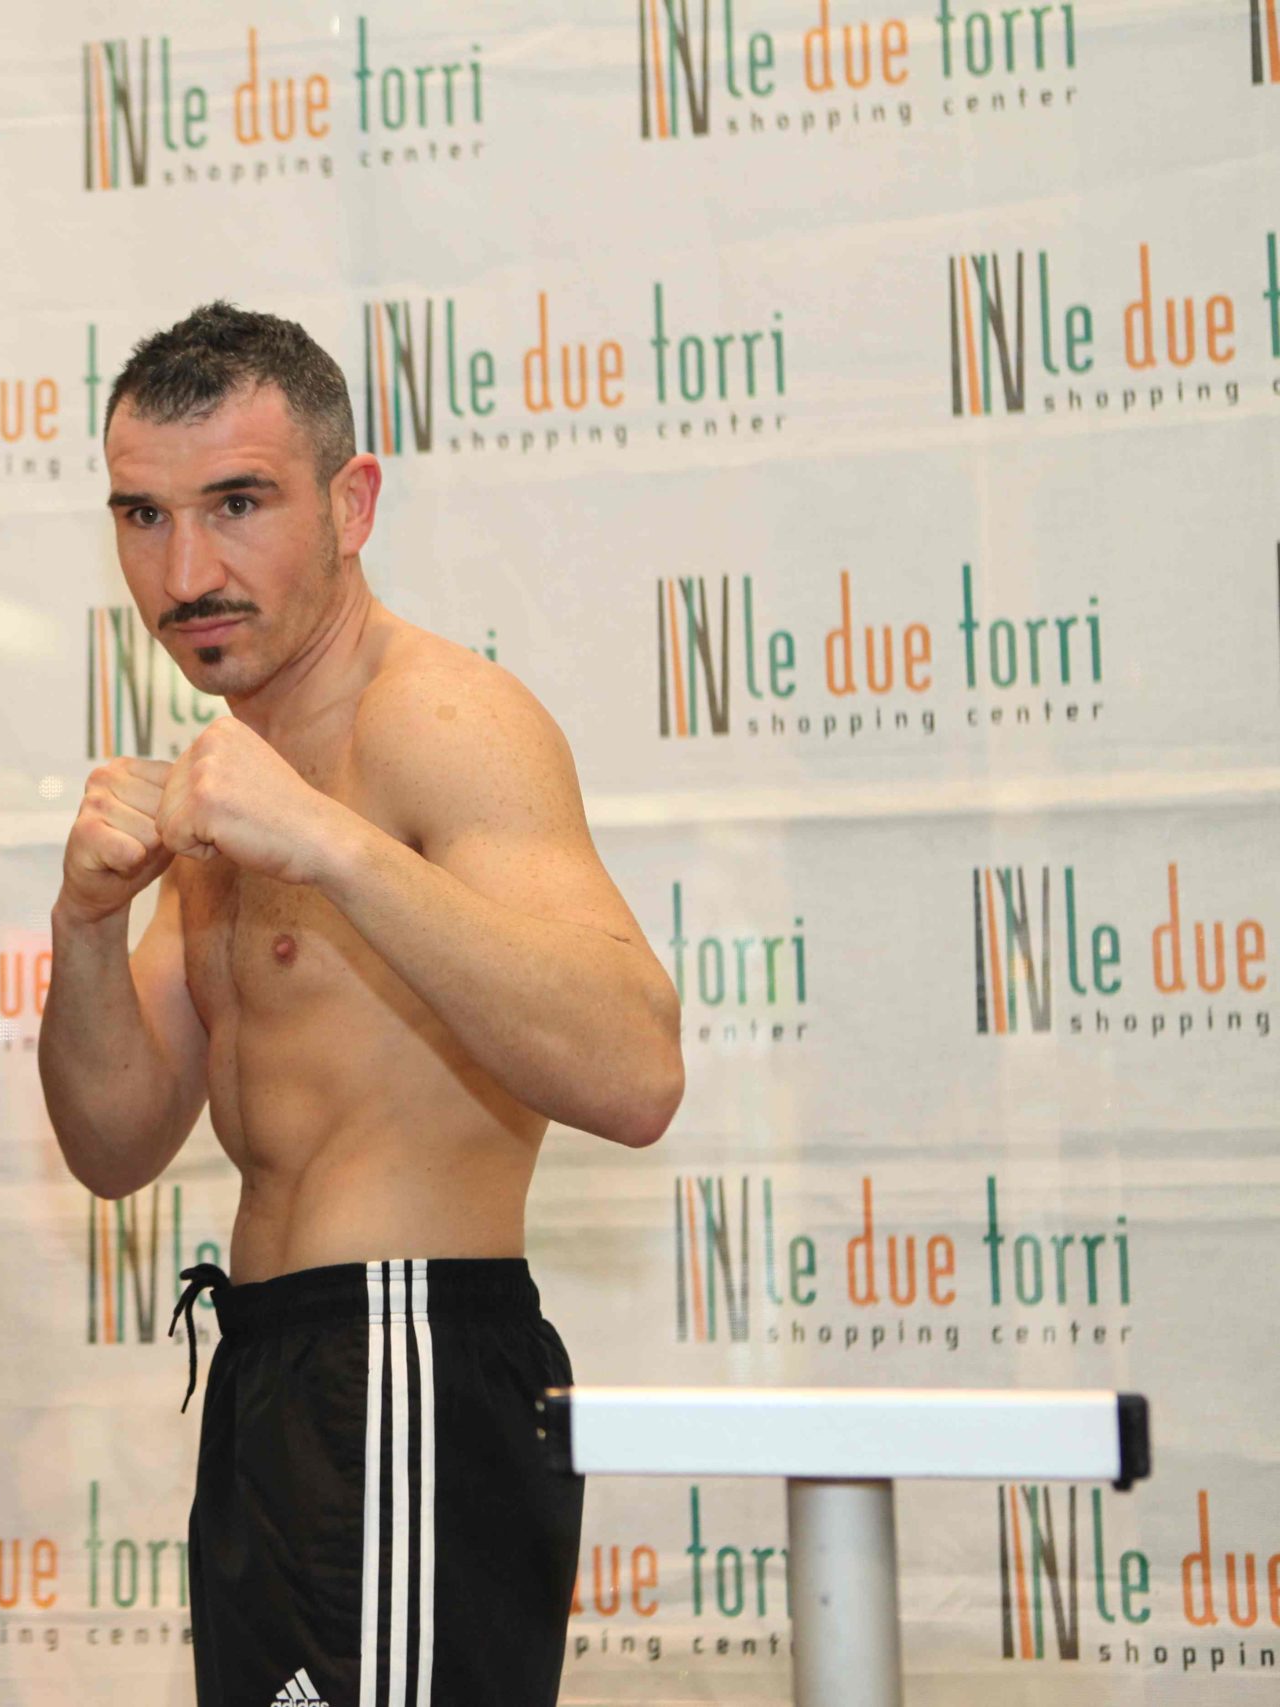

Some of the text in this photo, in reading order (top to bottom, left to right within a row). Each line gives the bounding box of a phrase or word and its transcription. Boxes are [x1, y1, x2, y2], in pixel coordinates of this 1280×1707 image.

[160, 16, 482, 150] le due torri
[719, 0, 1075, 97] le due torri
[727, 88, 1076, 134] shopping center
[163, 142, 483, 186] shopping center
[1039, 251, 1094, 374] le
[1124, 244, 1235, 369] due
[447, 283, 785, 416] le due torri
[1044, 379, 1239, 411] shopping
[449, 413, 784, 453] shopping center
[744, 564, 1103, 700] le due torri
[748, 701, 1102, 737] shopping center
[669, 881, 806, 1006] torri
[1064, 864, 1266, 996] le due
[699, 1016, 807, 1043] enter
[1071, 1008, 1269, 1037] shopping
[764, 1175, 1131, 1306] le due torri
[769, 1320, 1131, 1350] shopping center
[86, 1479, 189, 1608] torr
[571, 1484, 792, 1618] ue tor
[1091, 1487, 1151, 1625] le
[87, 1624, 193, 1646] cente
[575, 1630, 781, 1662] ping cent
[1099, 1640, 1274, 1671] shoppin
